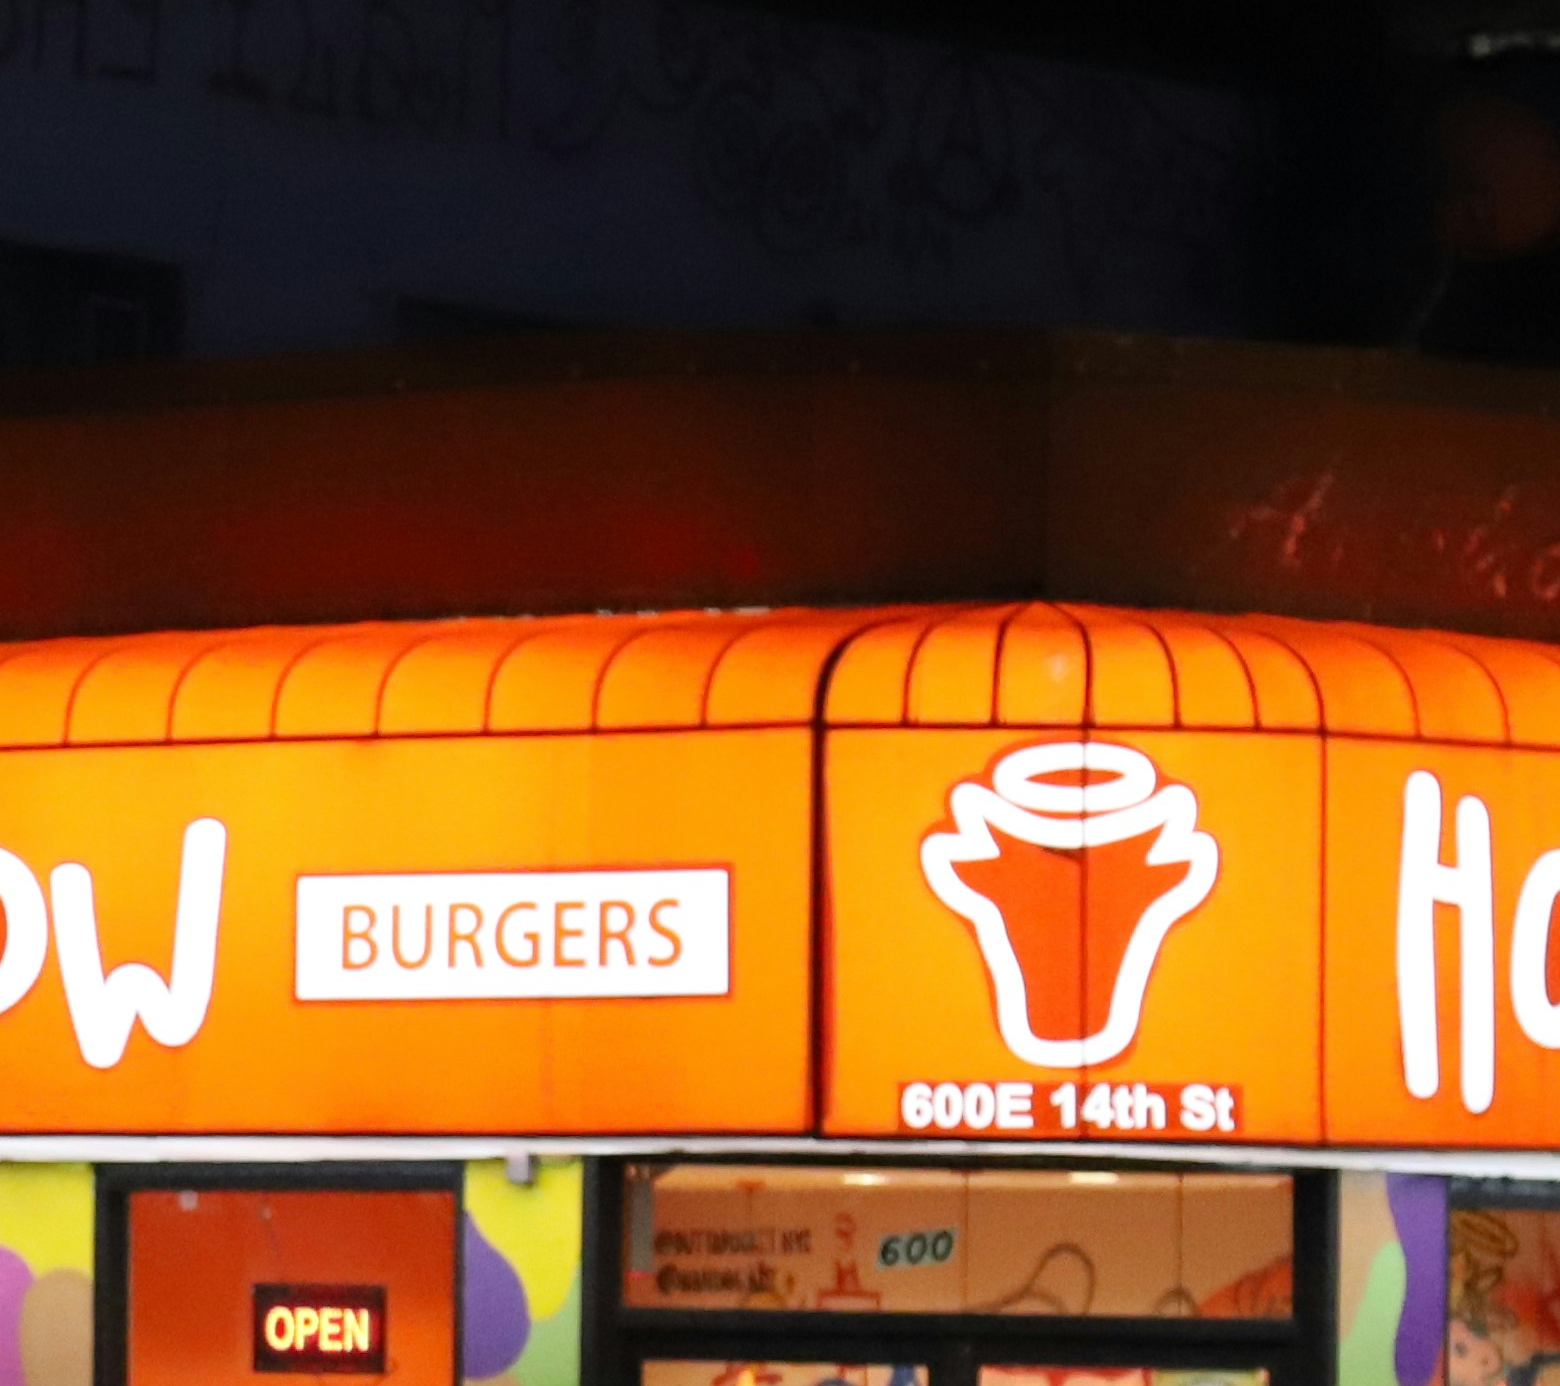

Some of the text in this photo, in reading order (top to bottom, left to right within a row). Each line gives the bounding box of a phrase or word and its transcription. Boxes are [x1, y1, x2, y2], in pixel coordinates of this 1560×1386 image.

[341, 899, 683, 971] BURGERS
[900, 1084, 1235, 1130] 600E 14th St
[879, 1228, 954, 1266] 600
[264, 1304, 370, 1352] OPEN
